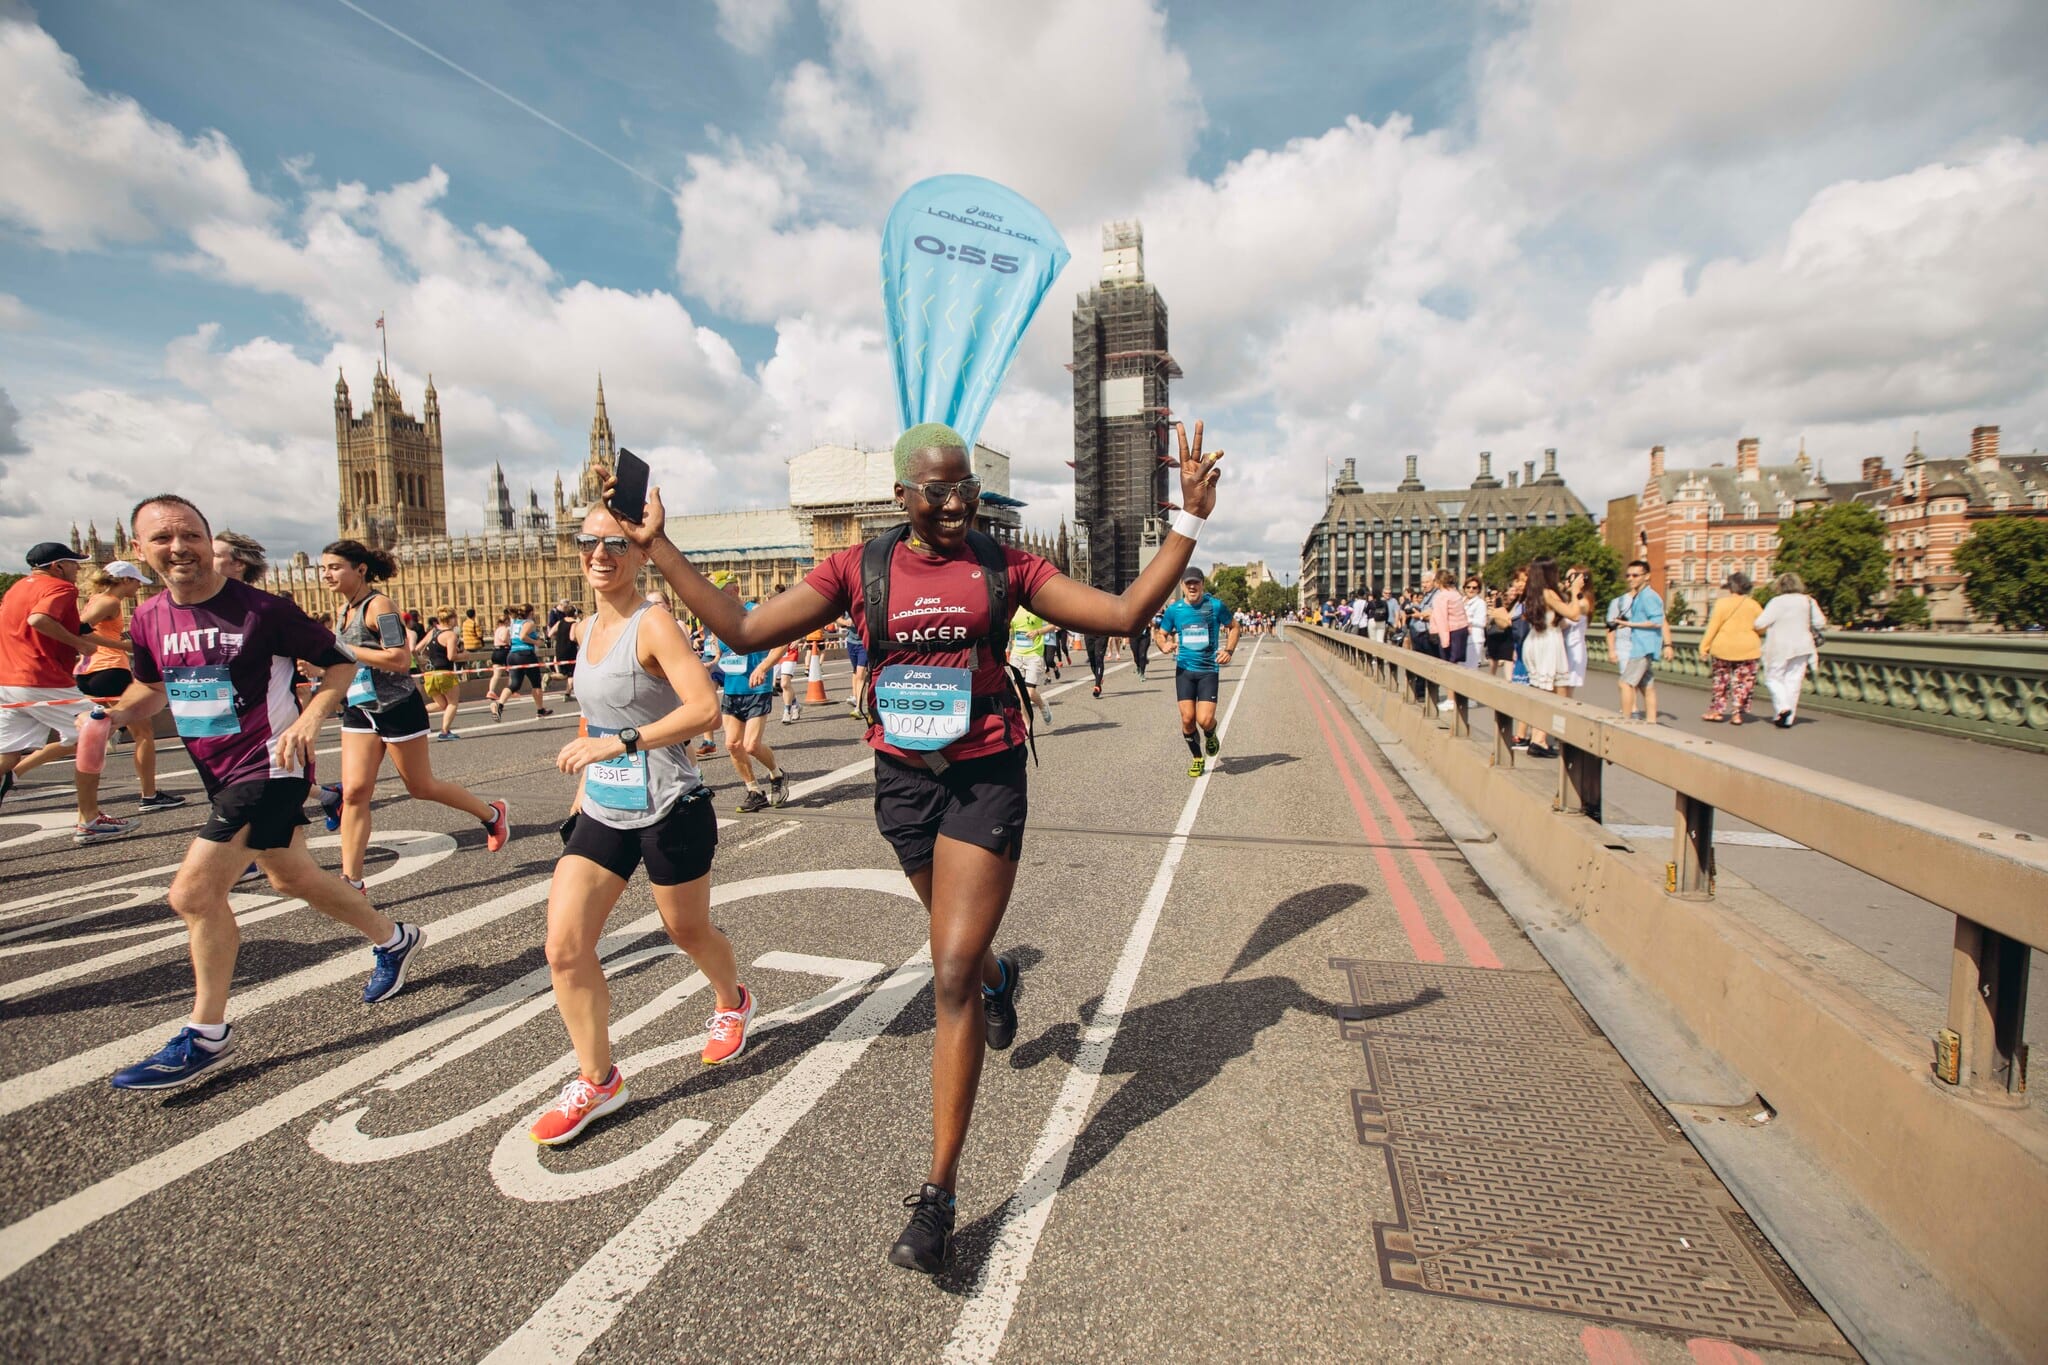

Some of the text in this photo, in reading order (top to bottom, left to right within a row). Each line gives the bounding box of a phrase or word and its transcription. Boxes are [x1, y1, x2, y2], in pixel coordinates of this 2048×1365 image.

[914, 235, 1019, 274] 0:55
[163, 627, 219, 656] MATT
[895, 626, 967, 643] PACER
[879, 698, 945, 711] D1899
[888, 713, 938, 736] DORA
[594, 765, 631, 782] JESSIE
